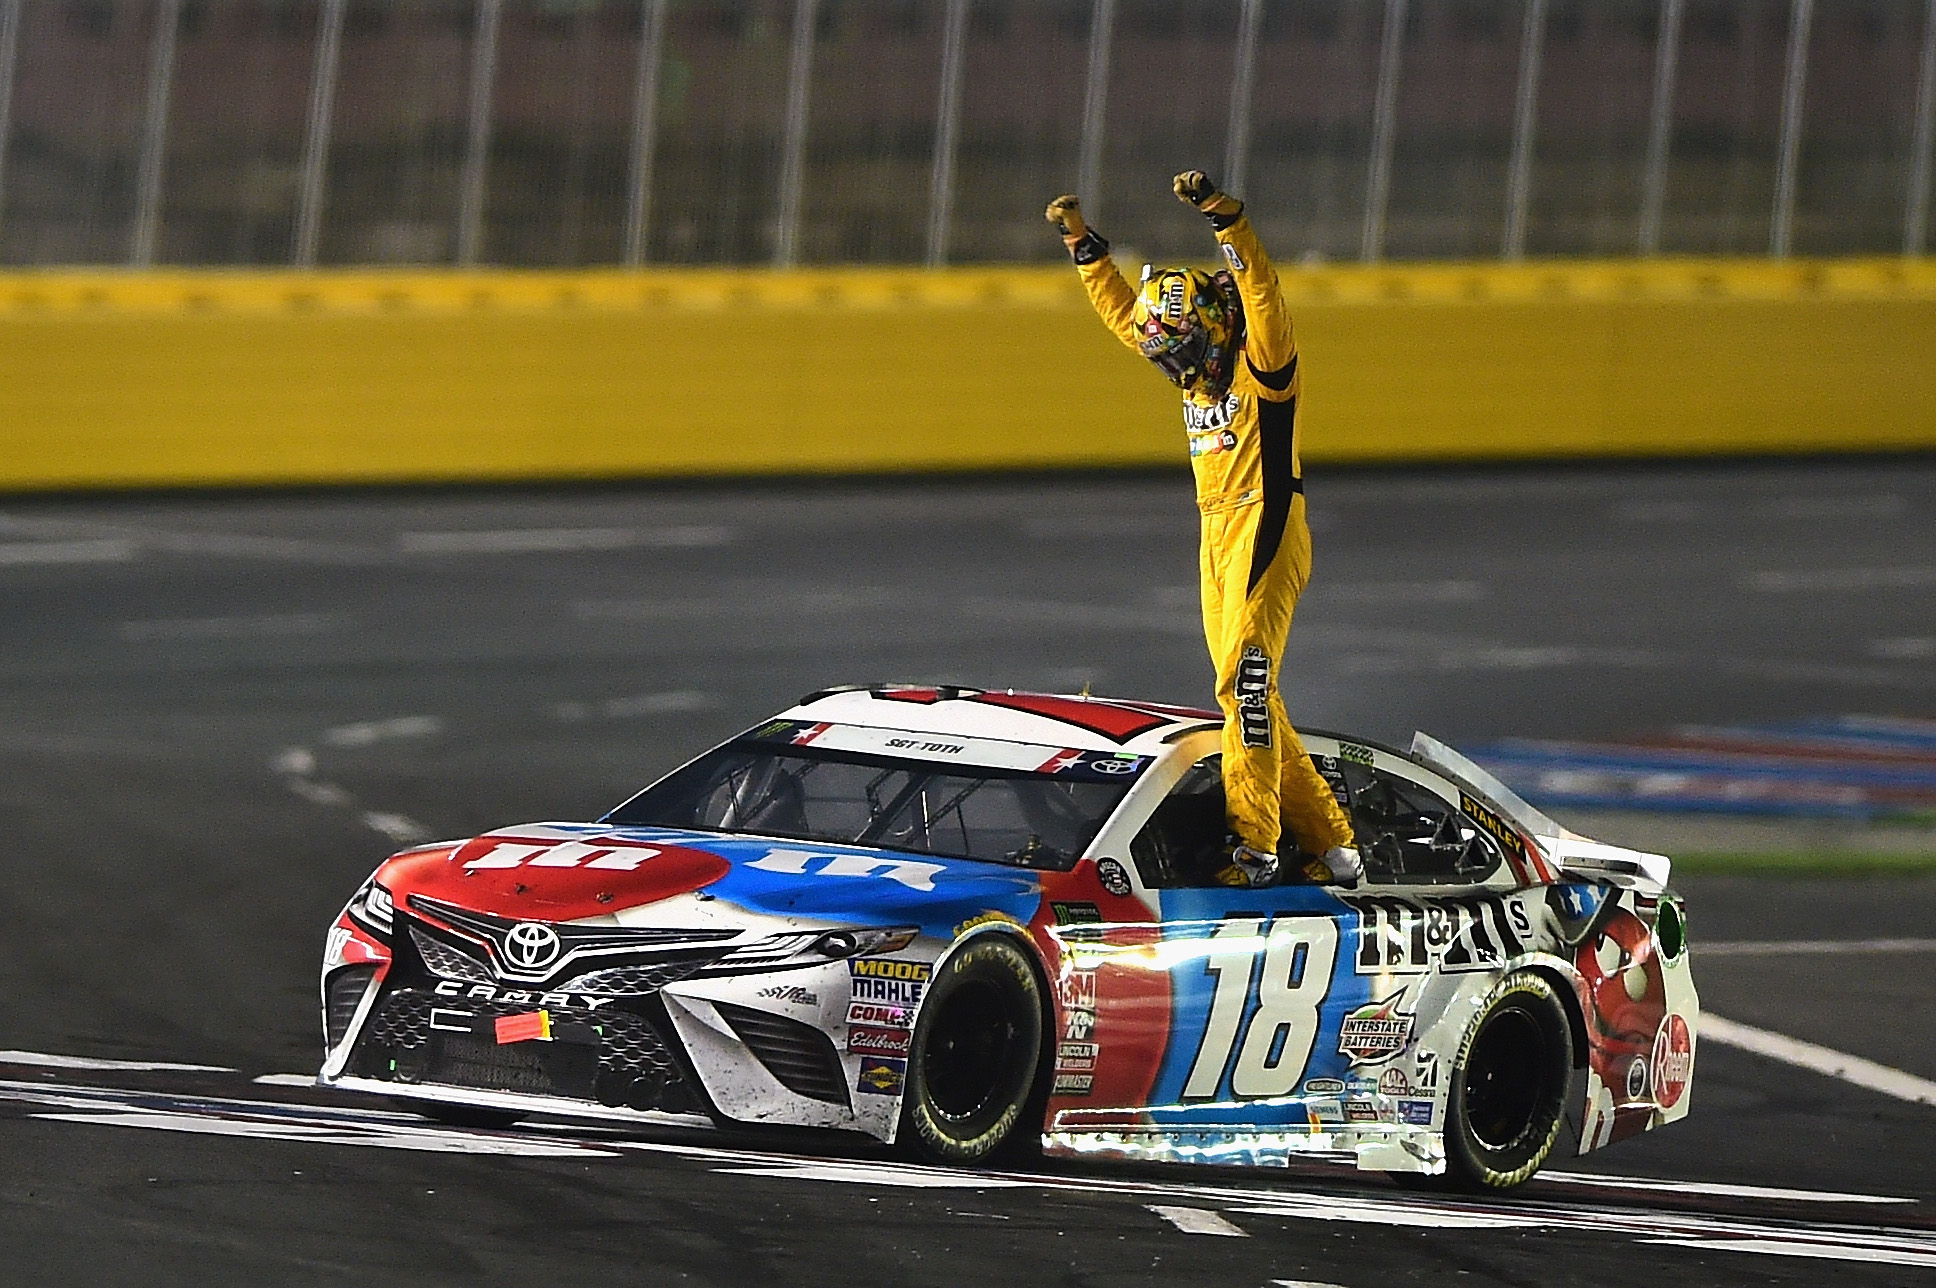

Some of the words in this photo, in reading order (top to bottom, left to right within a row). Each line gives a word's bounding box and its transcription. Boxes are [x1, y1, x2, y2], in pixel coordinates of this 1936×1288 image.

[884, 738, 920, 749] SGT
[920, 742, 965, 754] TOTH
[1463, 796, 1523, 854] STANLEY
[852, 960, 930, 981] MOOG
[433, 979, 615, 1011] CAMRY
[852, 977, 922, 1002] MAHLE
[1183, 916, 1339, 1098] 18
[1343, 1020, 1407, 1033] INTERSTATE
[850, 1031, 908, 1052] Edelbrock
[1343, 1036, 1401, 1048] BATTERIES
